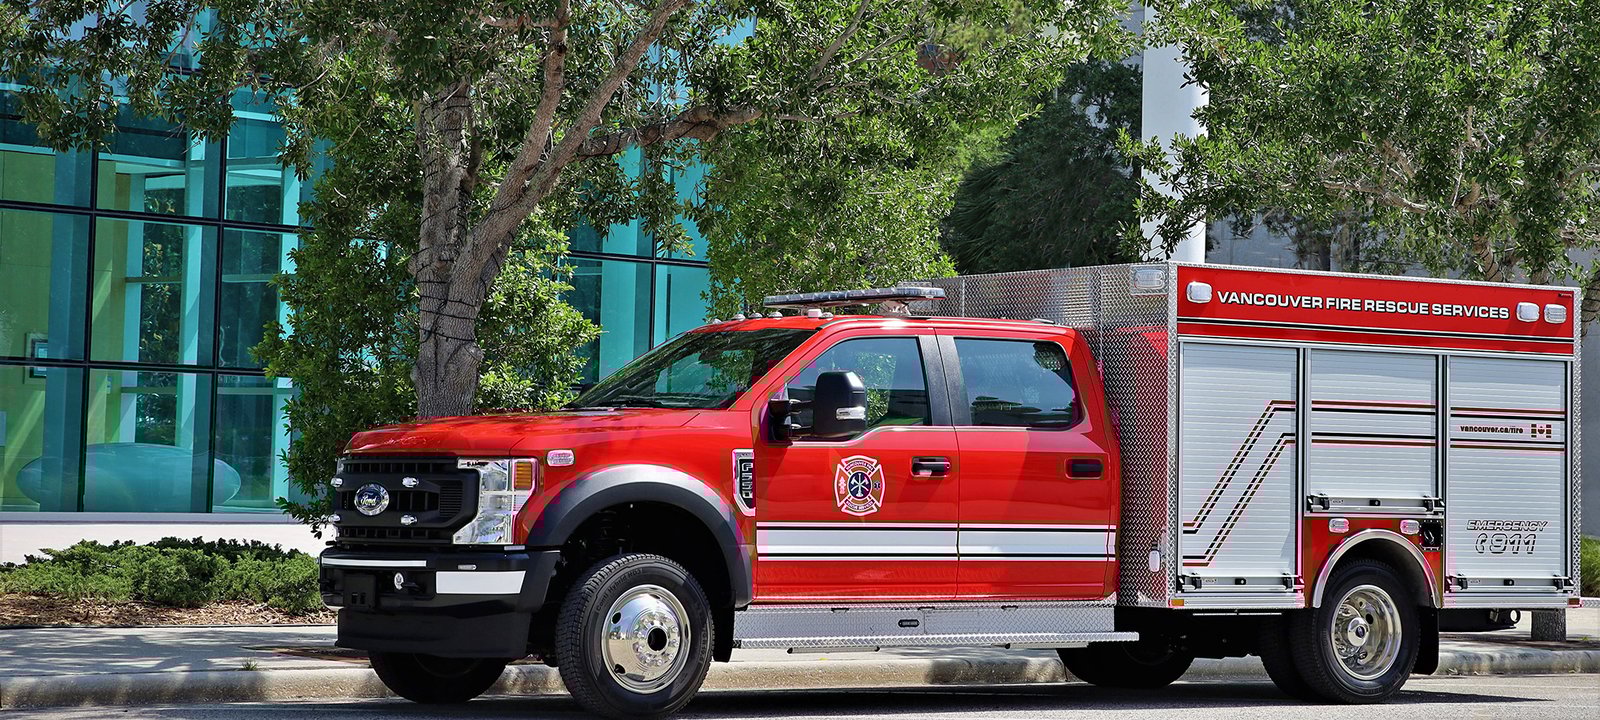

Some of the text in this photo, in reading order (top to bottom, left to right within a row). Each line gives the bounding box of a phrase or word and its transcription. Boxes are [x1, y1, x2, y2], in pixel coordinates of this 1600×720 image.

[1217, 290, 1510, 319] VANCOUVER FIRE RESCUE SERVICES
[741, 462, 753, 499] F550
[1467, 519, 1548, 532] EMERGENCY
[1489, 533, 1537, 555] 911
